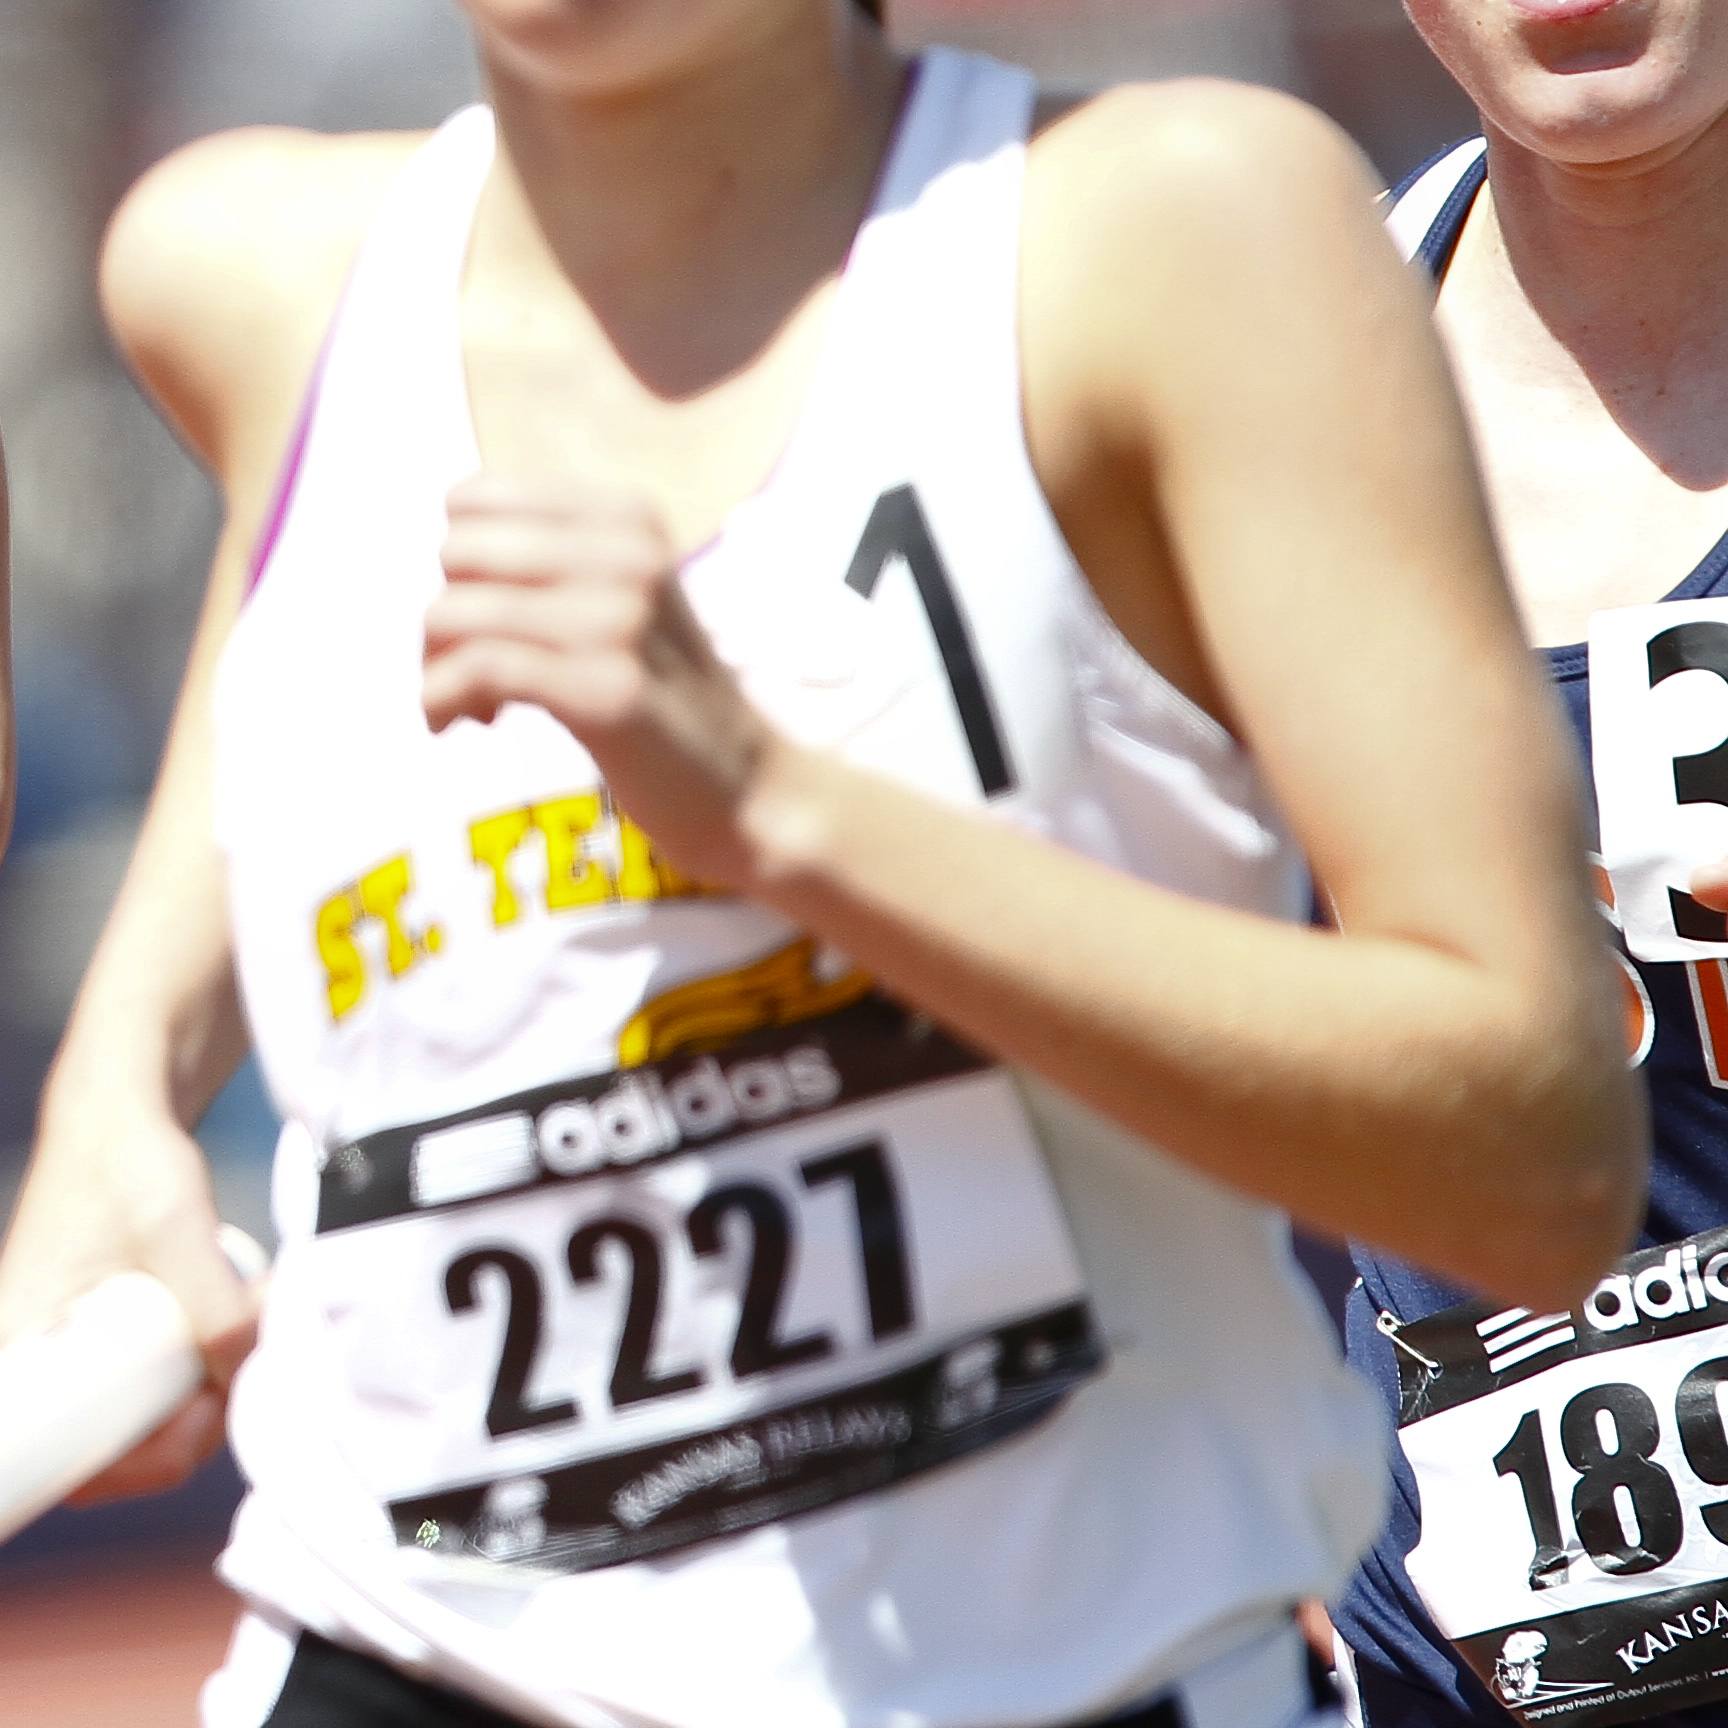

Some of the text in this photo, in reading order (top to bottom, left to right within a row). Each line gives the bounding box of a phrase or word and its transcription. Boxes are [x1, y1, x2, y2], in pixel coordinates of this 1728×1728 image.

[844, 482, 1017, 800] 1
[316, 848, 443, 1024] ST.
[536, 1044, 843, 1175] adidas
[441, 1130, 920, 1441] 2227
